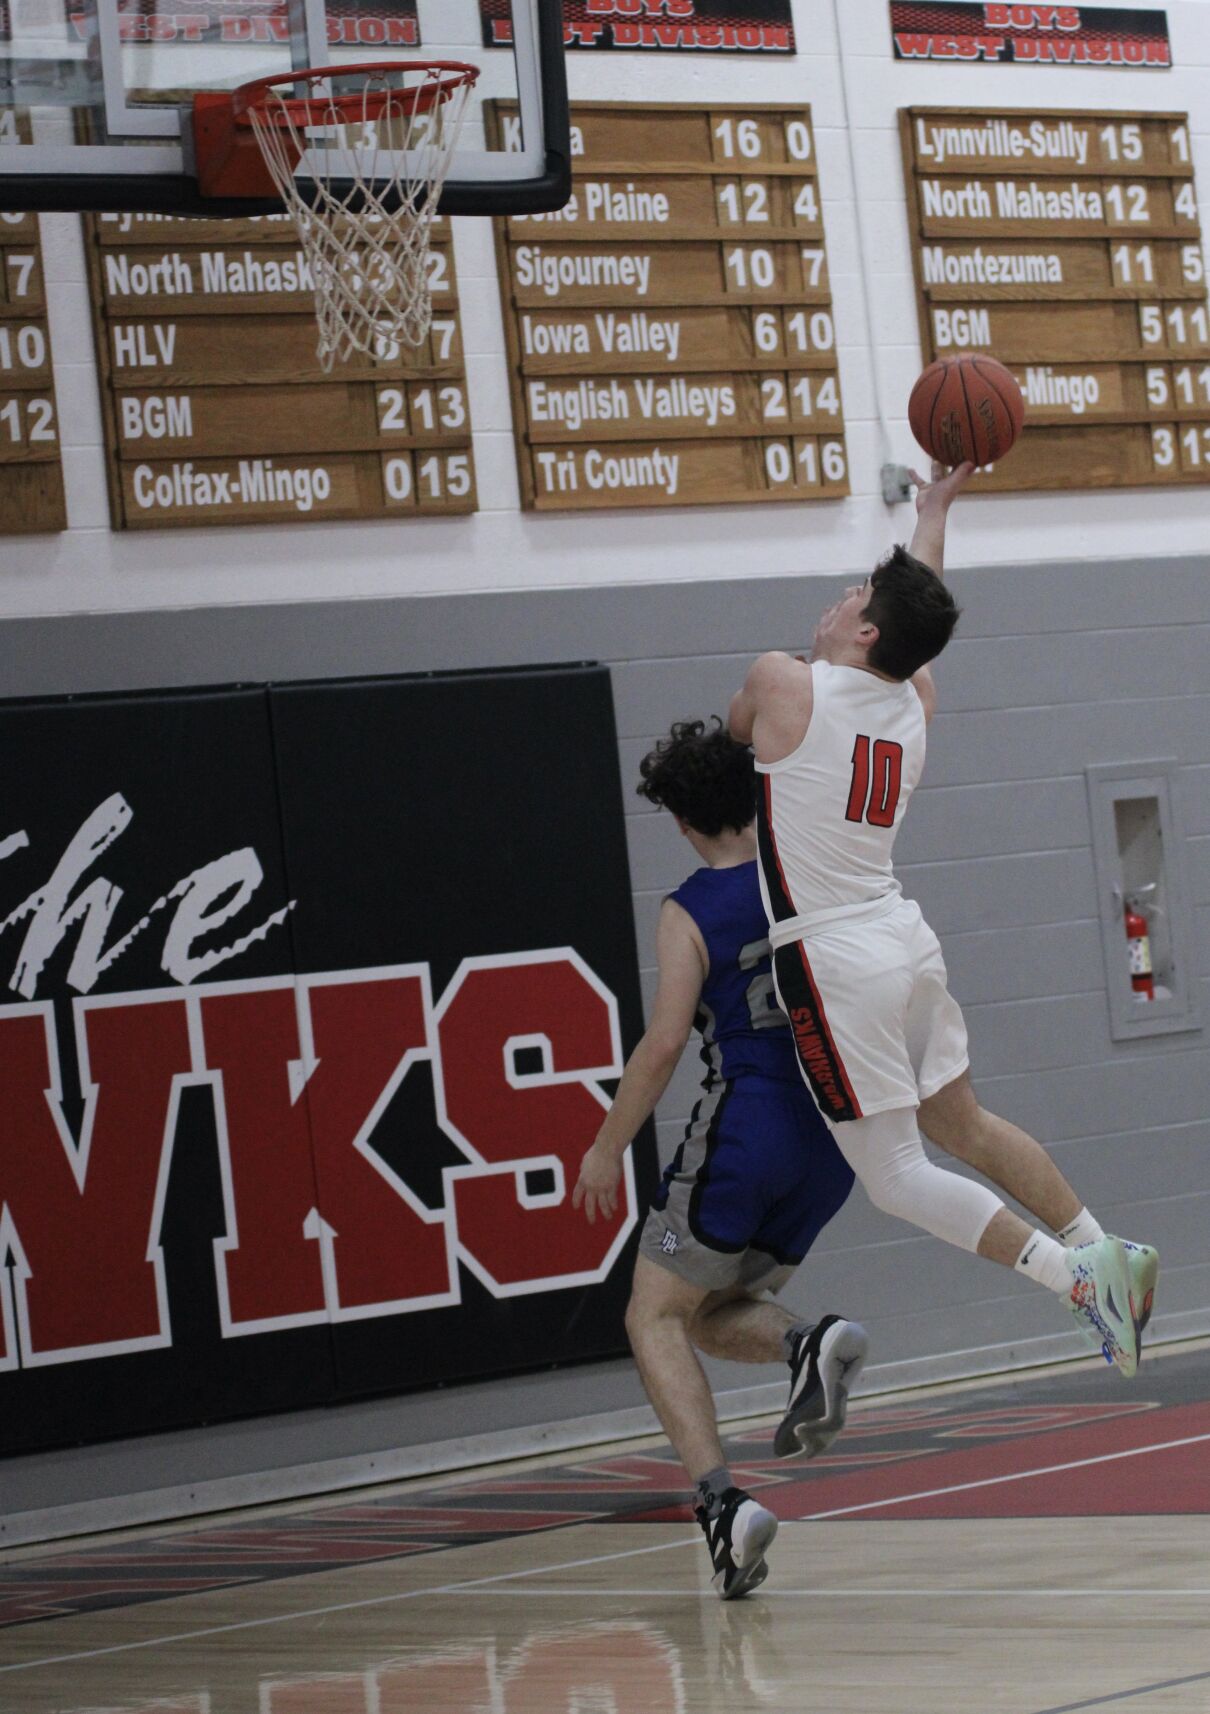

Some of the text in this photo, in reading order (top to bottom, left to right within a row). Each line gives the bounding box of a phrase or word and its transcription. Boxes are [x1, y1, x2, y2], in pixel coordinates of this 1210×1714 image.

[611, 22, 790, 50] DIVISION
[983, 3, 1081, 30] BOYS
[894, 33, 1170, 66] WEST DIVISION
[715, 119, 811, 159] 16 0
[916, 117, 1189, 164] Lynnville-Sully 15 1
[585, 183, 669, 223] Plaine
[719, 183, 768, 222] 12
[794, 184, 818, 221] 4
[922, 180, 1197, 221] North Mahaska 12 4
[8, 255, 35, 296] 7
[105, 252, 194, 296] North
[515, 246, 825, 295] Sigourney 10 7
[921, 245, 1203, 284] Montezuma 11 5
[114, 325, 176, 367] HLV
[431, 320, 456, 360] 7
[522, 311, 834, 361] Iowa Valley 6 10
[932, 306, 1209, 347] BGM 5 11
[528, 376, 841, 431] English Valleys 2 14
[1146, 367, 1169, 406] 5
[0, 399, 57, 442] 12
[122, 386, 466, 440] BGM 2 13
[537, 441, 846, 495] Tri County 0 16
[1153, 428, 1175, 466] 3
[133, 455, 471, 511] Colfax-Mingo 0 15
[844, 733, 904, 828] 10
[0, 791, 298, 1001] he
